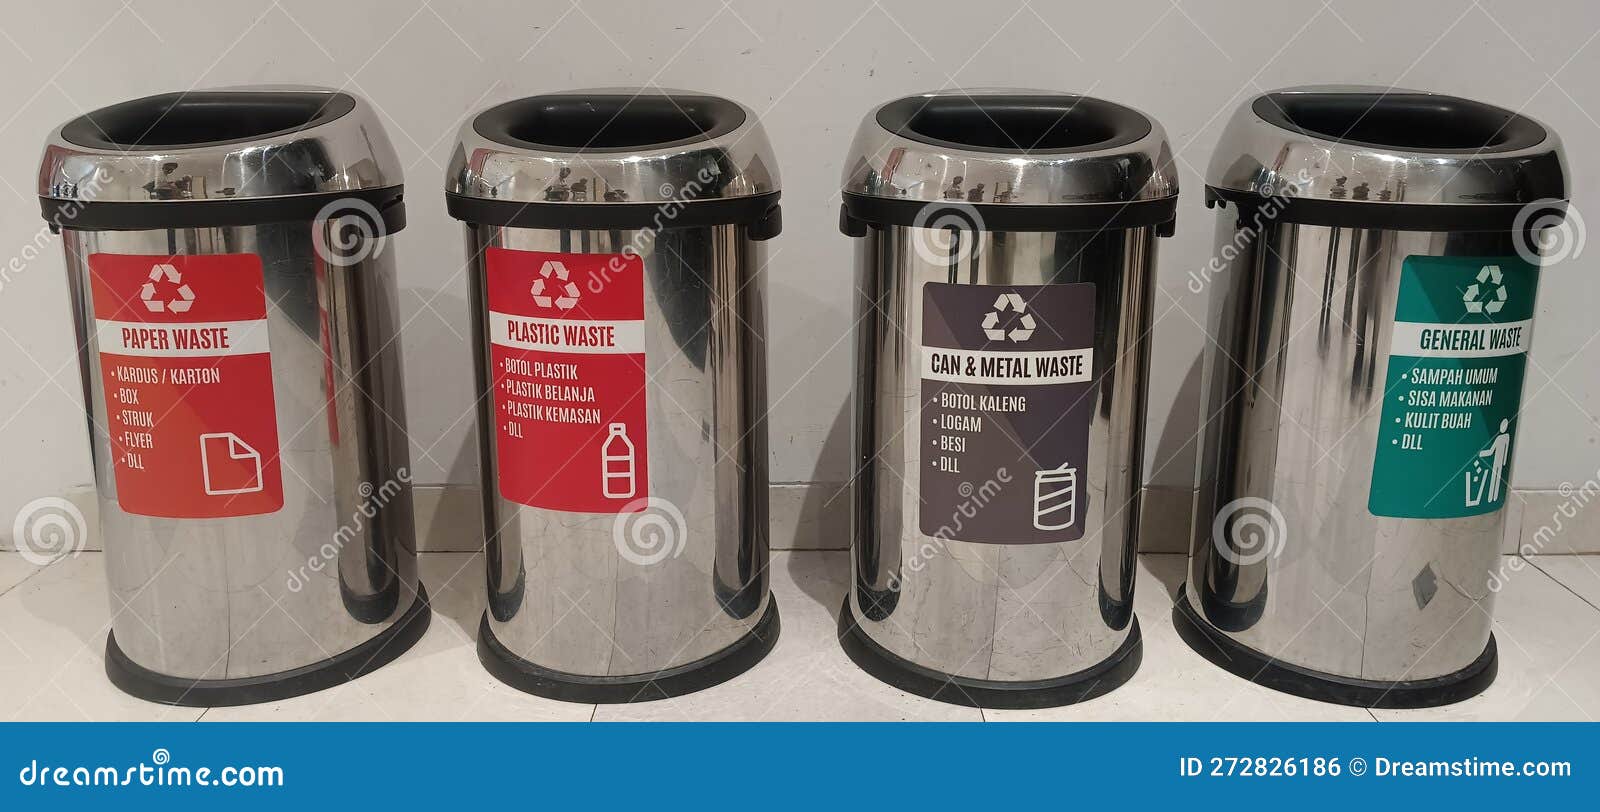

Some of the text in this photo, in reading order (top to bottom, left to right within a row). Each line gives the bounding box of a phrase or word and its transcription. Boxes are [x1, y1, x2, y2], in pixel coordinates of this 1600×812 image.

[122, 327, 230, 350] PAPER WASTE
[507, 319, 615, 347] PLASTIC WASTE
[1420, 326, 1522, 351] GENERAL WASTE
[117, 365, 158, 384] KARDUS
[170, 367, 220, 384] KARTON
[505, 357, 578, 380] BOTOL PLASTIK
[931, 353, 1083, 378] CAN & METAL WASTE
[1411, 367, 1498, 385] SAMPAH UMUM
[119, 387, 140, 405] BOX
[506, 378, 595, 403] PLASTIK BELANJA
[1408, 389, 1493, 407] SISA MAKANAN
[507, 399, 601, 424] PLASTIK KEMASAN
[941, 392, 1026, 412] BOTOL KALENG
[122, 409, 155, 428] STRUK
[941, 413, 982, 433] LOGAM
[1404, 411, 1472, 429] KULIT BUAH
[508, 421, 523, 439] DLL
[124, 431, 154, 449] FLYER
[940, 434, 966, 453] BESI
[1401, 433, 1423, 451] DLL
[127, 452, 145, 470] DLL
[940, 456, 960, 474] DLL
